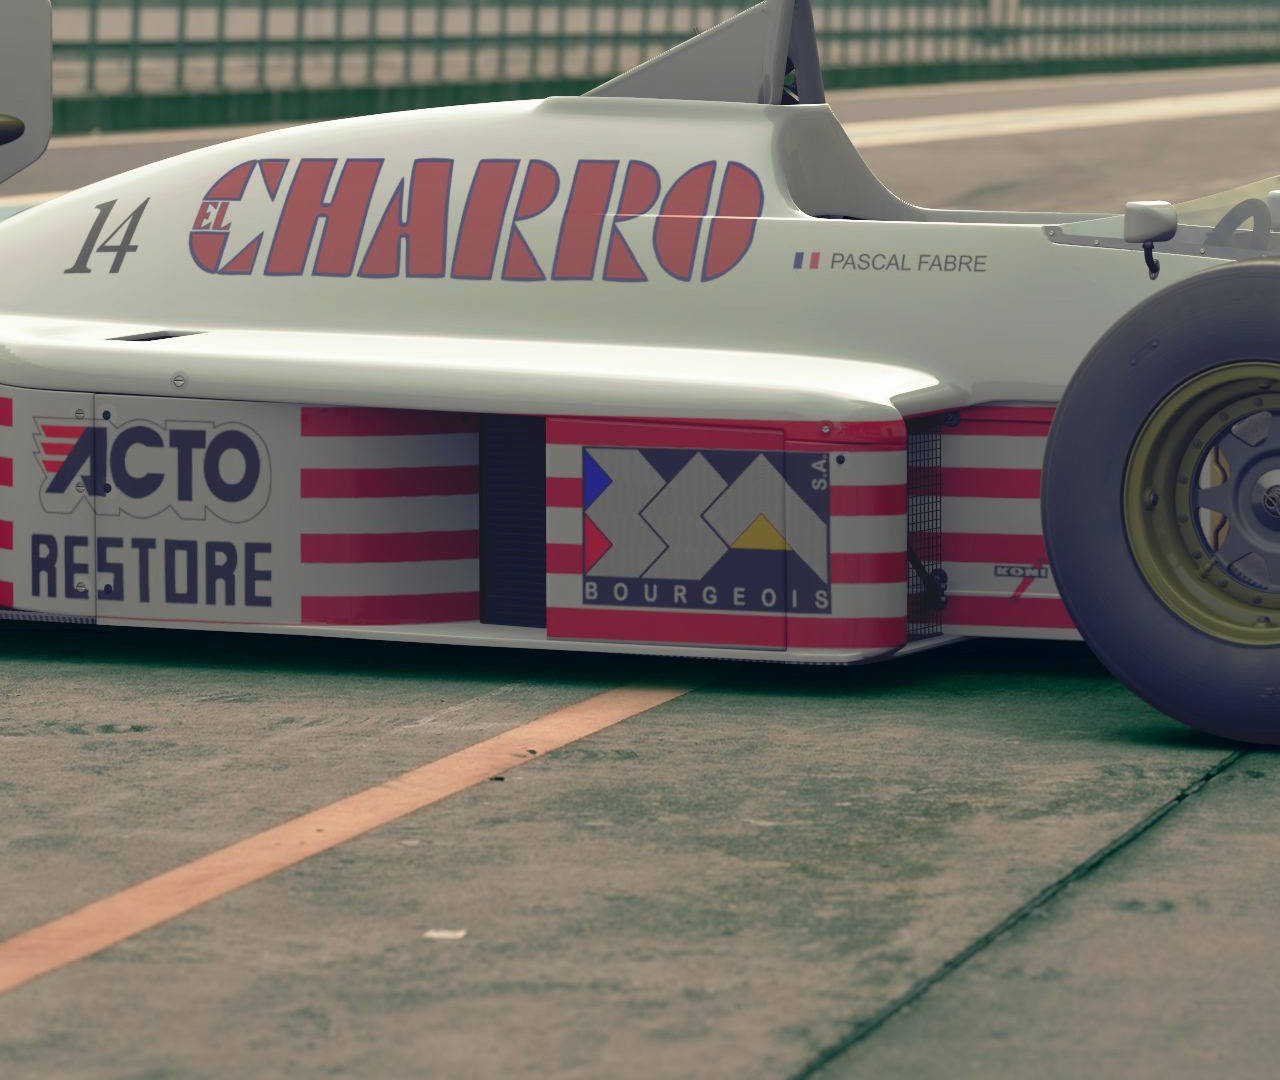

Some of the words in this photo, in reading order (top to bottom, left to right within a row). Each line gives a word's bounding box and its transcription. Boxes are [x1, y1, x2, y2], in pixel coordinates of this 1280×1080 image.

[64, 197, 151, 274] 14
[188, 158, 765, 282] CHARRO
[192, 201, 232, 230] EL
[830, 252, 912, 271] PASCAL
[917, 254, 988, 273] FABRE
[39, 424, 261, 503] ACTO
[30, 533, 272, 608] RESTORE
[584, 581, 829, 609] BOURGEOIS
[994, 565, 1048, 578] KONI
